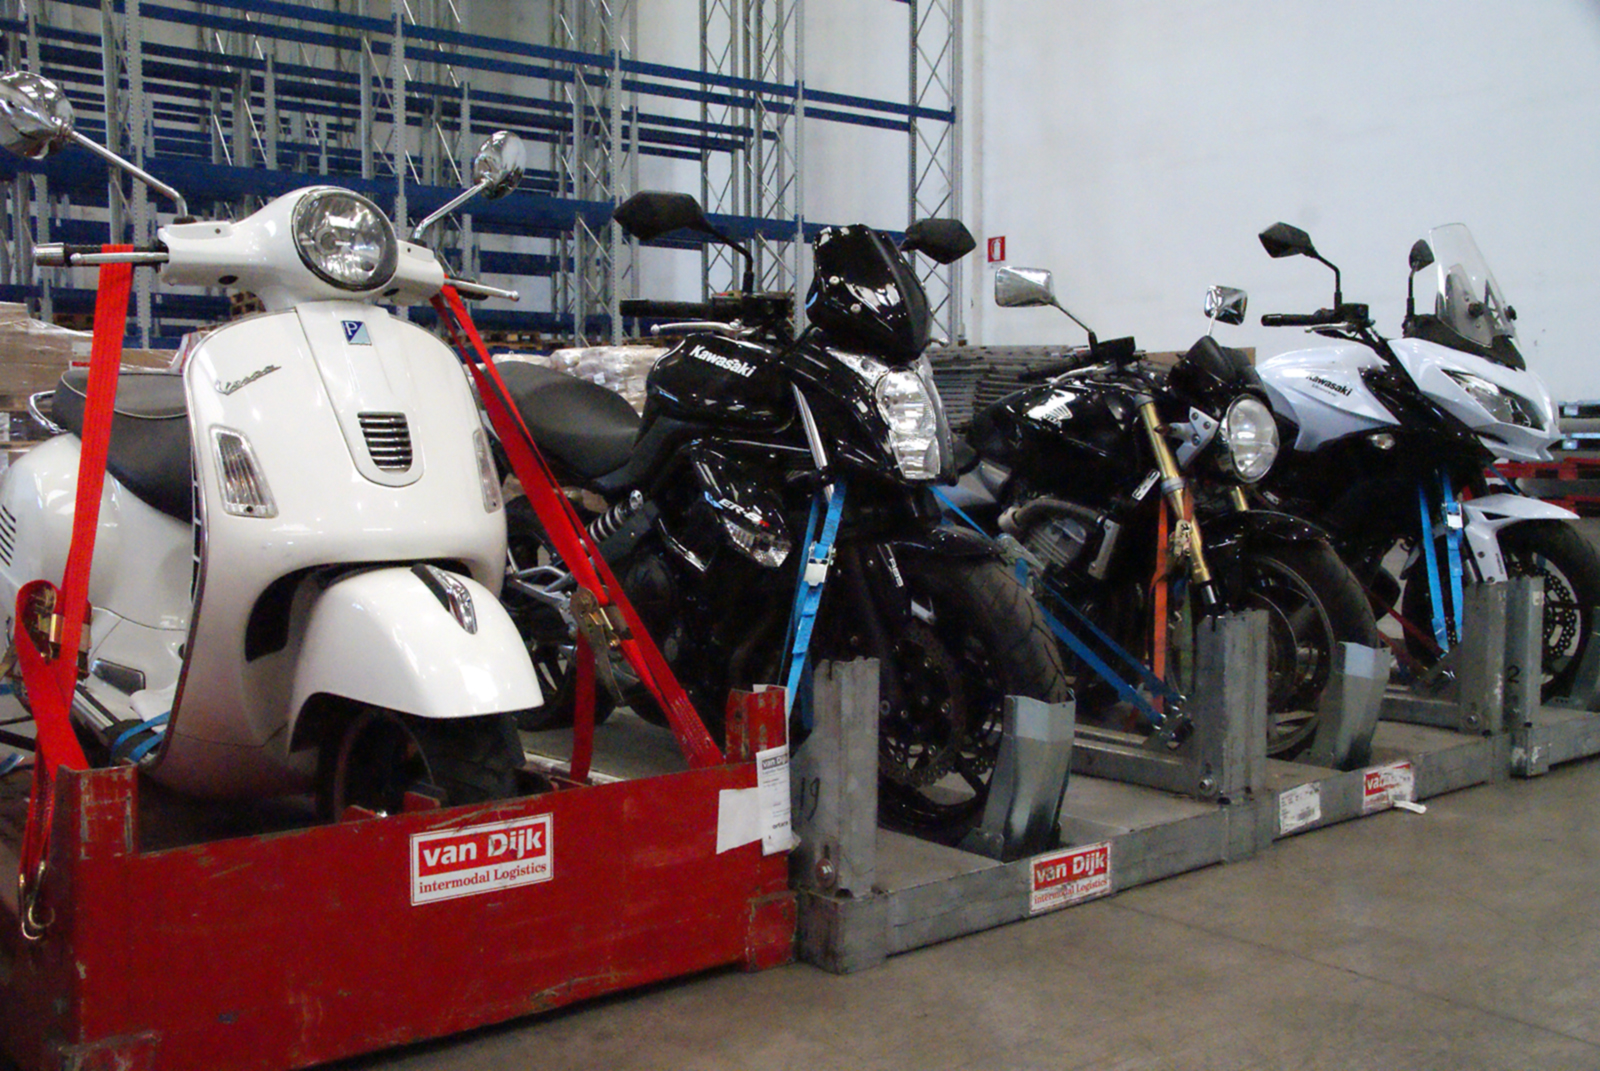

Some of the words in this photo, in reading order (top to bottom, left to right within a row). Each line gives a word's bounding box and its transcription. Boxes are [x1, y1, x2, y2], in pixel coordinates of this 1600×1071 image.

[689, 344, 757, 378] Kawasaki
[1507, 664, 1521, 684] 2
[799, 776, 821, 821] 19
[423, 841, 477, 867] van
[487, 828, 543, 859] Dijk
[419, 871, 490, 894] intermodal
[493, 863, 547, 881] Logistics
[1036, 863, 1067, 883] van
[1072, 851, 1106, 875] Dijk
